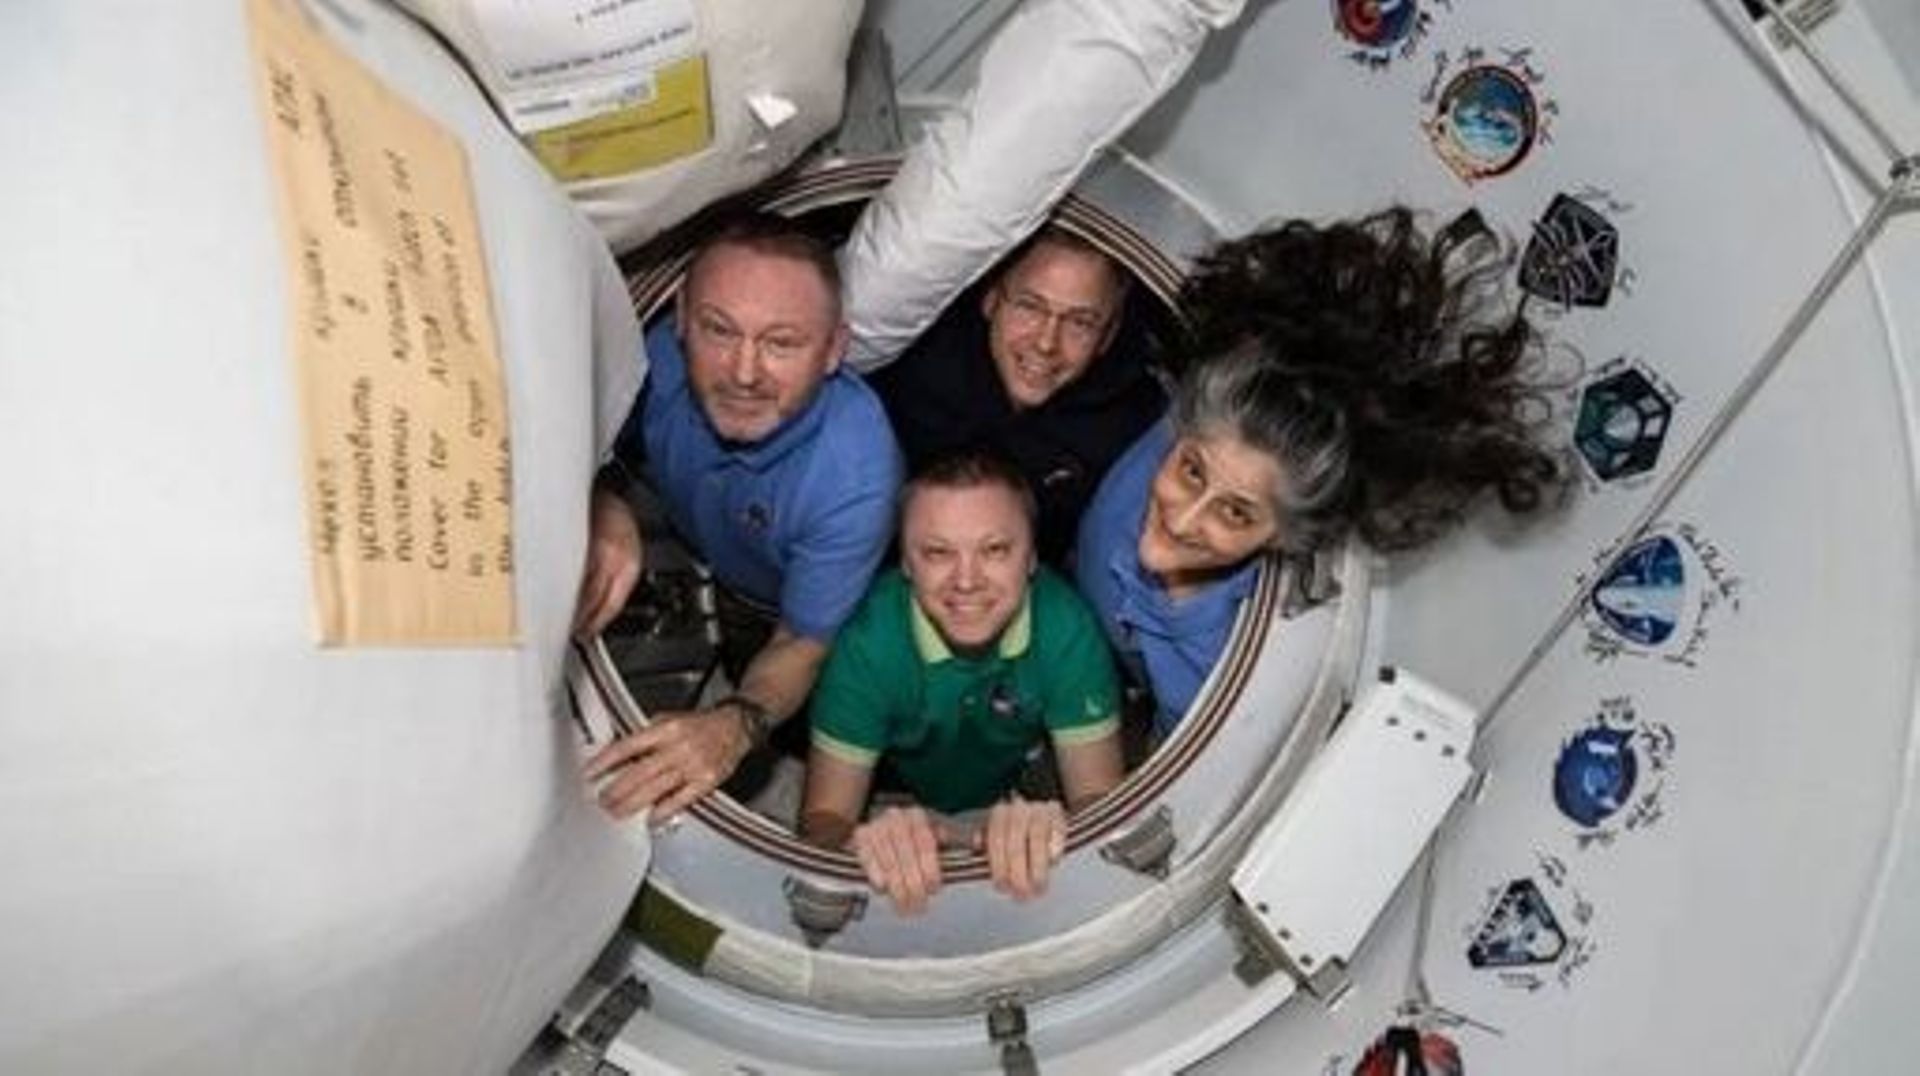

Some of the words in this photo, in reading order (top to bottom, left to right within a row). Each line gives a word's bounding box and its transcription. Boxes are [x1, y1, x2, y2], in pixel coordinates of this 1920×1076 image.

[465, 377, 490, 439] open
[346, 375, 386, 562] установить
[427, 430, 448, 471] for
[462, 478, 484, 521] the
[426, 496, 449, 571] Cover
[468, 552, 485, 578] in
